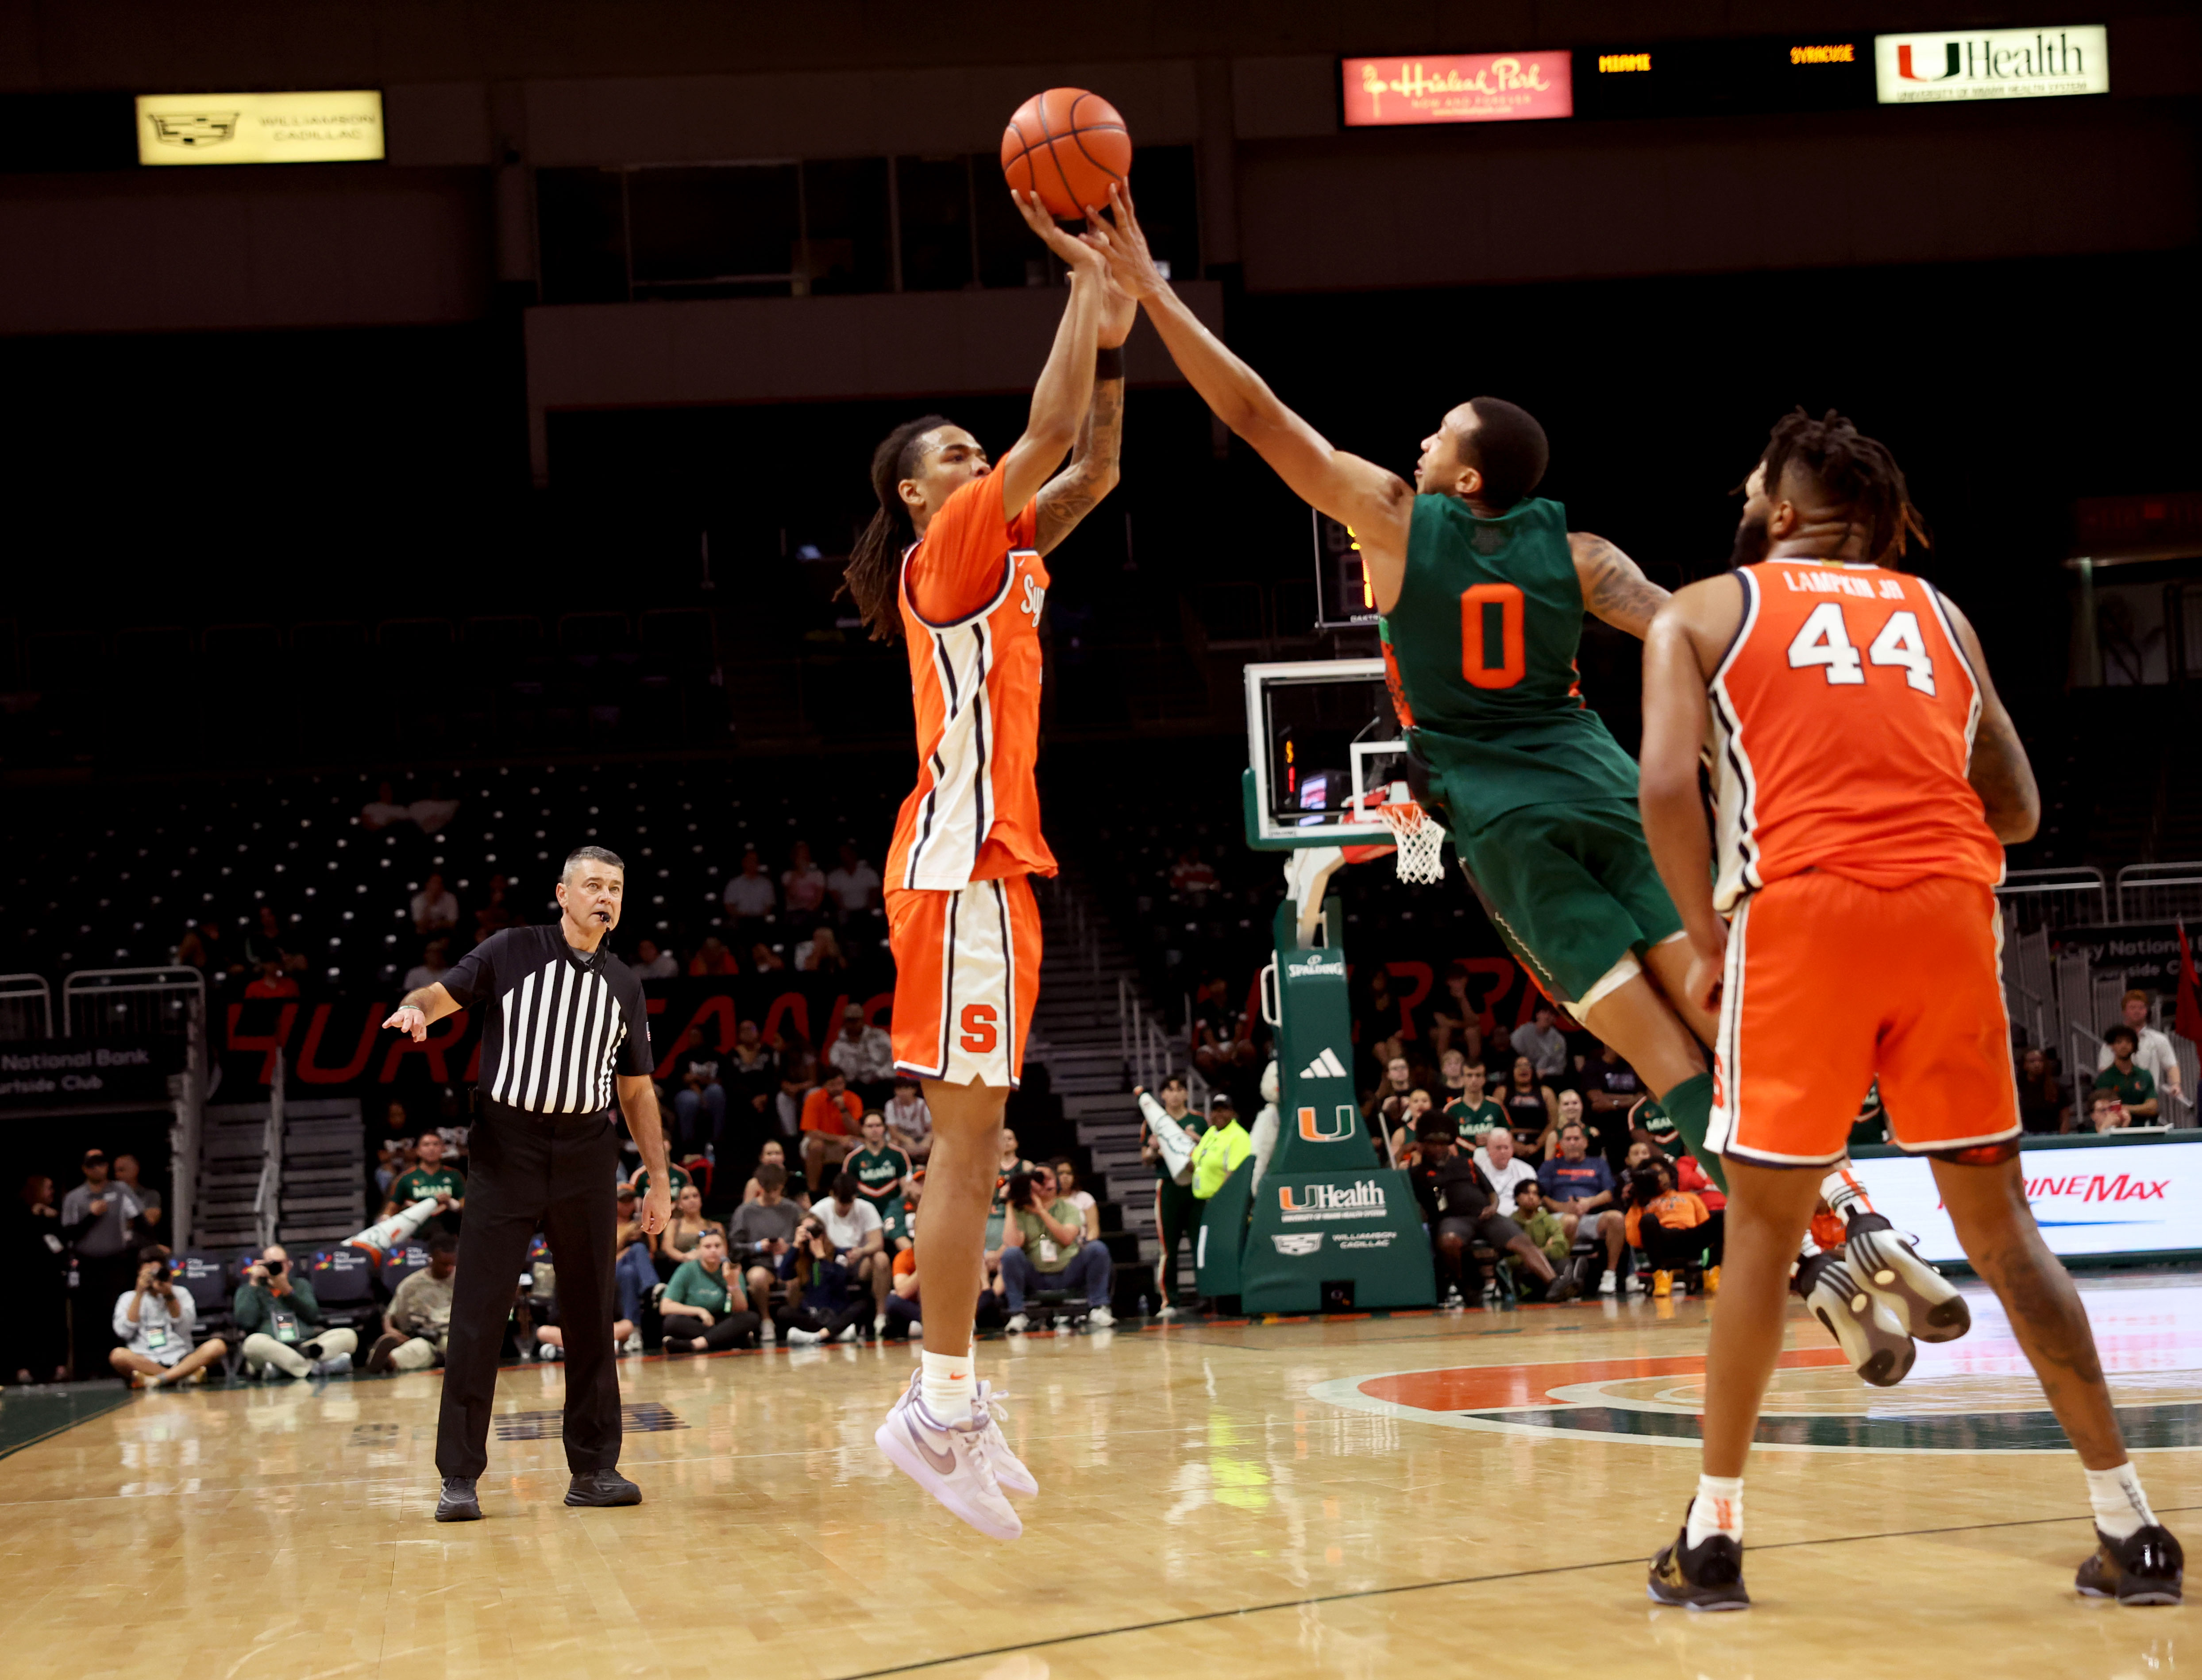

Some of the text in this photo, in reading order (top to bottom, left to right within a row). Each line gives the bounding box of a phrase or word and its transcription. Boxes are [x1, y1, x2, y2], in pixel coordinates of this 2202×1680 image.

[1897, 29, 2084, 82] UHealth
[1491, 58, 1550, 92] Park
[1782, 570, 1905, 600] LAMPKIN JR
[1461, 582, 1526, 690] 0
[1787, 602, 1938, 697] 44
[1288, 961, 1344, 978] SPALDING
[960, 1003, 997, 1053] S
[0, 1046, 152, 1071] National Bank
[1297, 1105, 1355, 1142] U
[1278, 1179, 1385, 1211] UHealth
